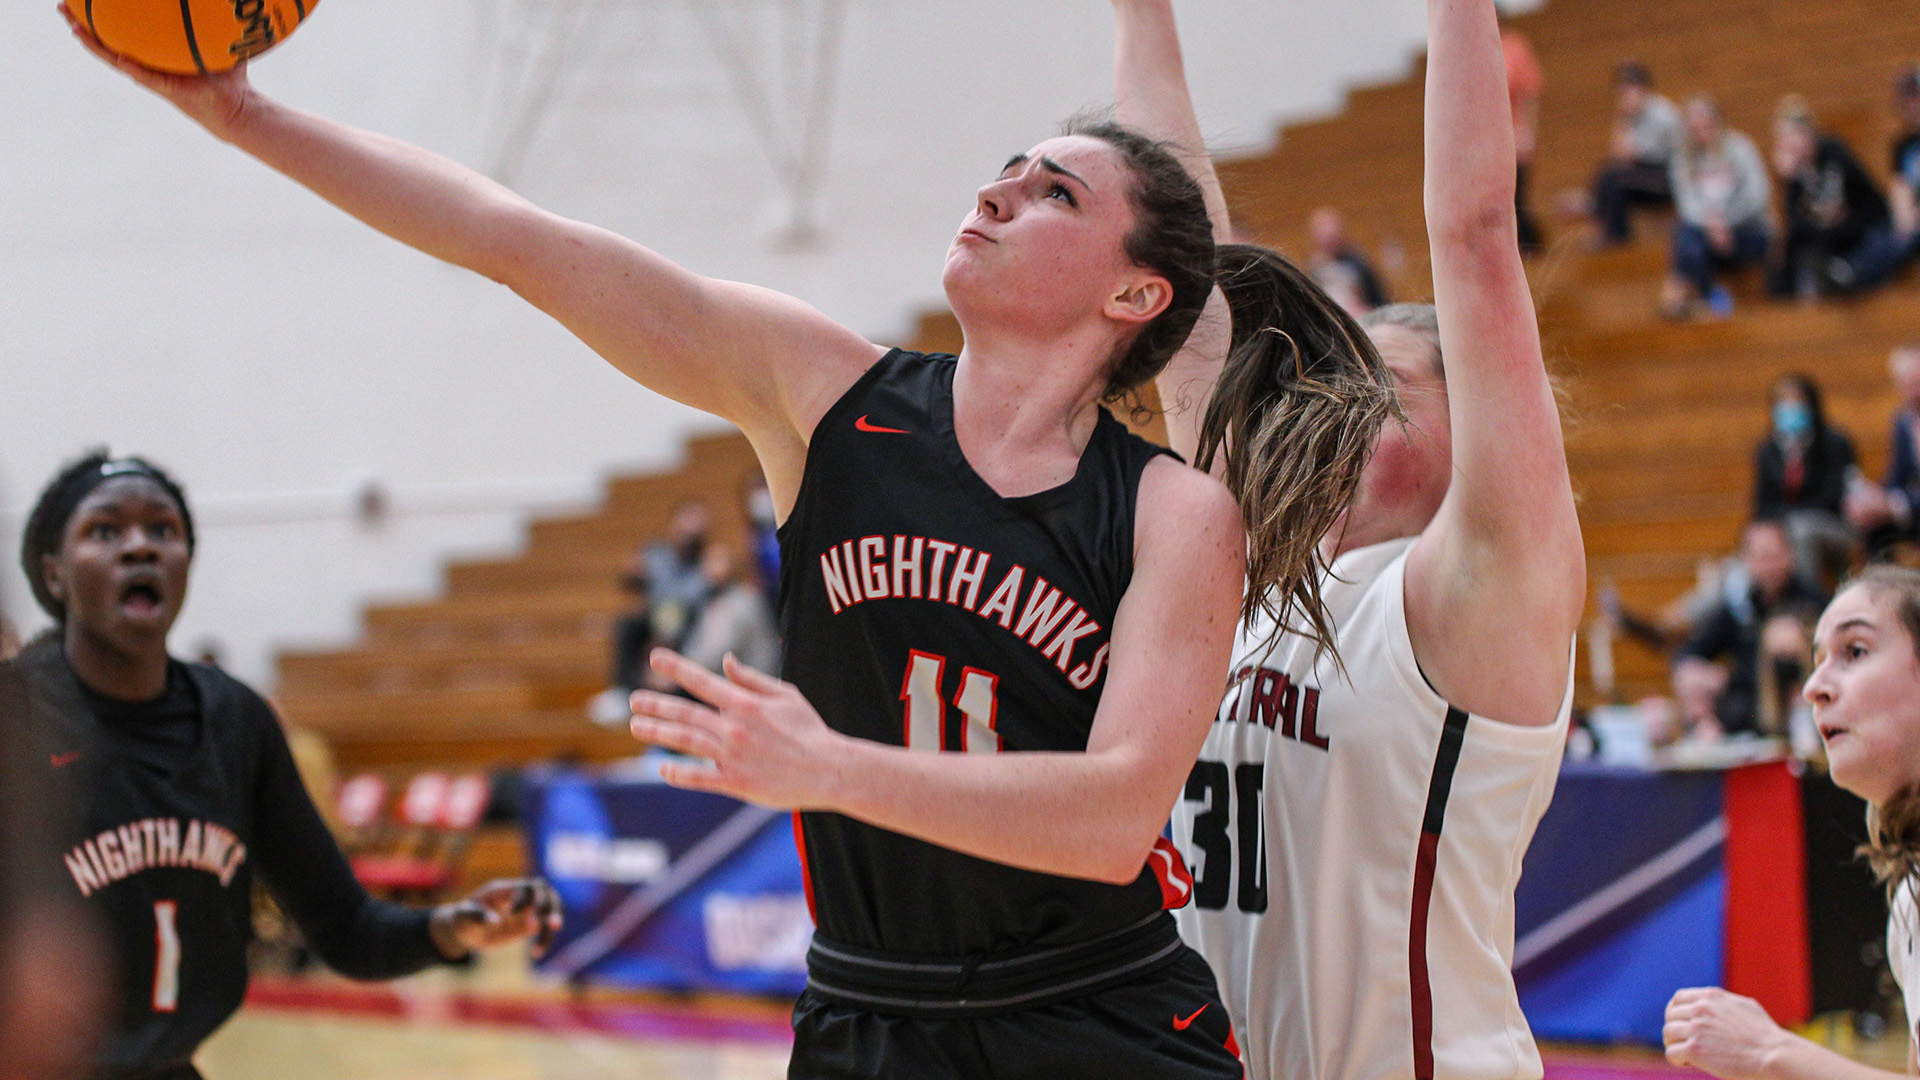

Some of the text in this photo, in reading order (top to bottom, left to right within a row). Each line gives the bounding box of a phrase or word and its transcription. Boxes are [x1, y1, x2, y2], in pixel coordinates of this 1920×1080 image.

[820, 534, 1110, 690] NIGHTHAWKS
[900, 648, 1004, 753] 11
[1214, 664, 1330, 752] TRAL
[1183, 758, 1269, 914] 30
[151, 899, 182, 1013] 1
